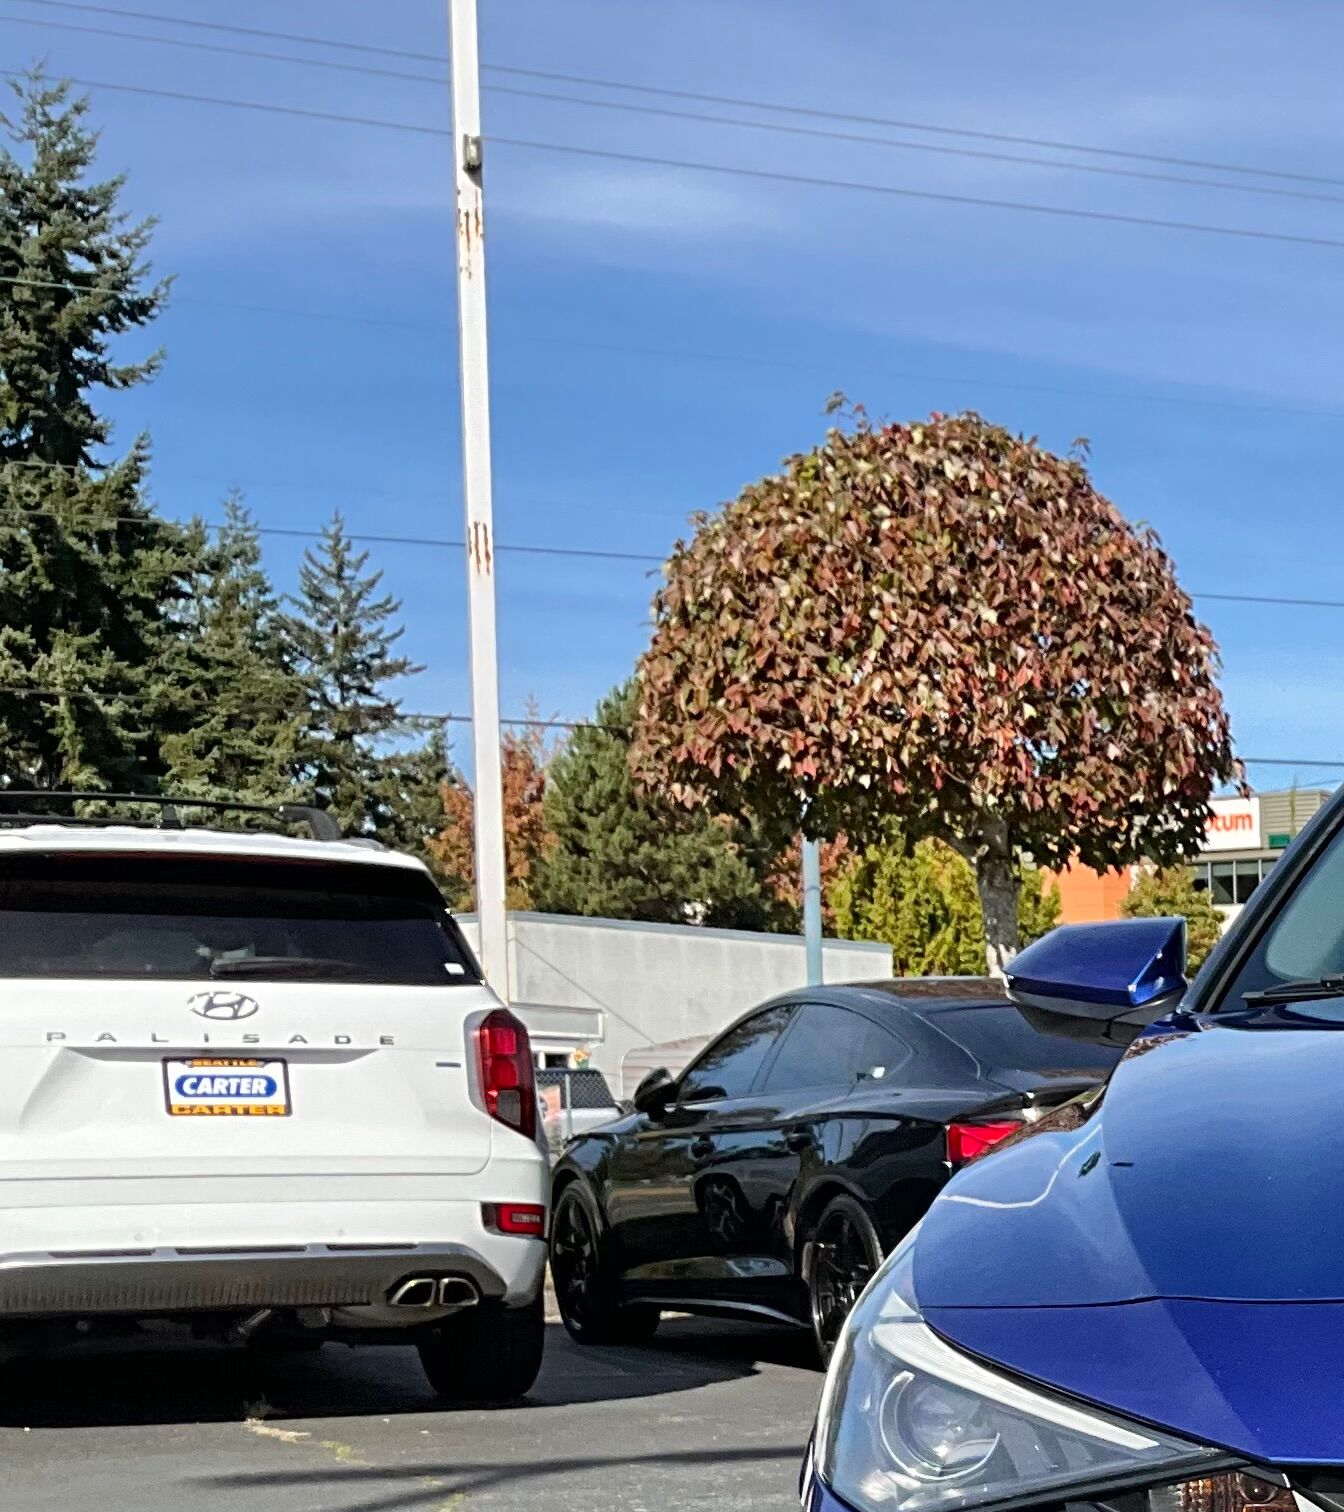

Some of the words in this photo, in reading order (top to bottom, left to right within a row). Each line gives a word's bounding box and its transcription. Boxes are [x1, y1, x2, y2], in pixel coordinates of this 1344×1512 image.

[46, 1031, 395, 1046] PALISADE
[192, 1059, 258, 1067] SEATTLE
[182, 1077, 269, 1095] CARTER
[172, 1104, 287, 1115] CARTER
